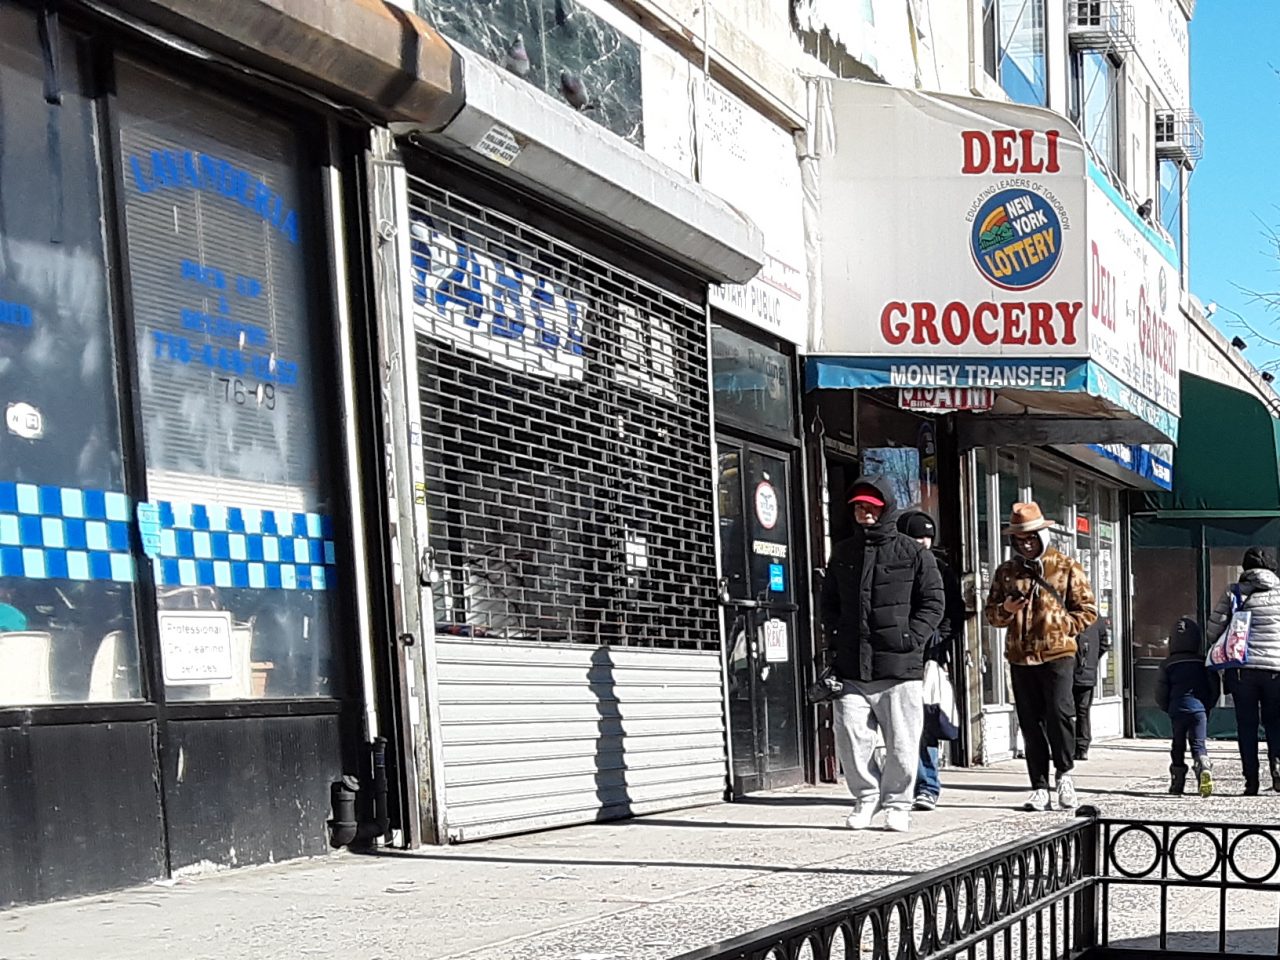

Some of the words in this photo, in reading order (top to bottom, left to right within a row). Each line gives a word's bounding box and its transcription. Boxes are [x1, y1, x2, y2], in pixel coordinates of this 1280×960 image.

[961, 129, 1060, 174] DELI
[965, 186, 997, 223] EDUCATING
[996, 178, 1031, 191] LEADERS
[1032, 182, 1043, 192] OF
[1042, 187, 1072, 231] TOMORROW
[1005, 194, 1034, 219] NEW
[1012, 209, 1049, 237] YORK
[984, 227, 1057, 279] LOTTERY
[750, 284, 782, 327] PUBLIC
[879, 301, 1084, 347] GROCERY
[1091, 239, 1117, 334] DELI
[1138, 283, 1178, 380] GROCERY
[218, 377, 277, 411] 76-9
[890, 364, 960, 386] MONEY
[965, 365, 1067, 387] TRANSFER
